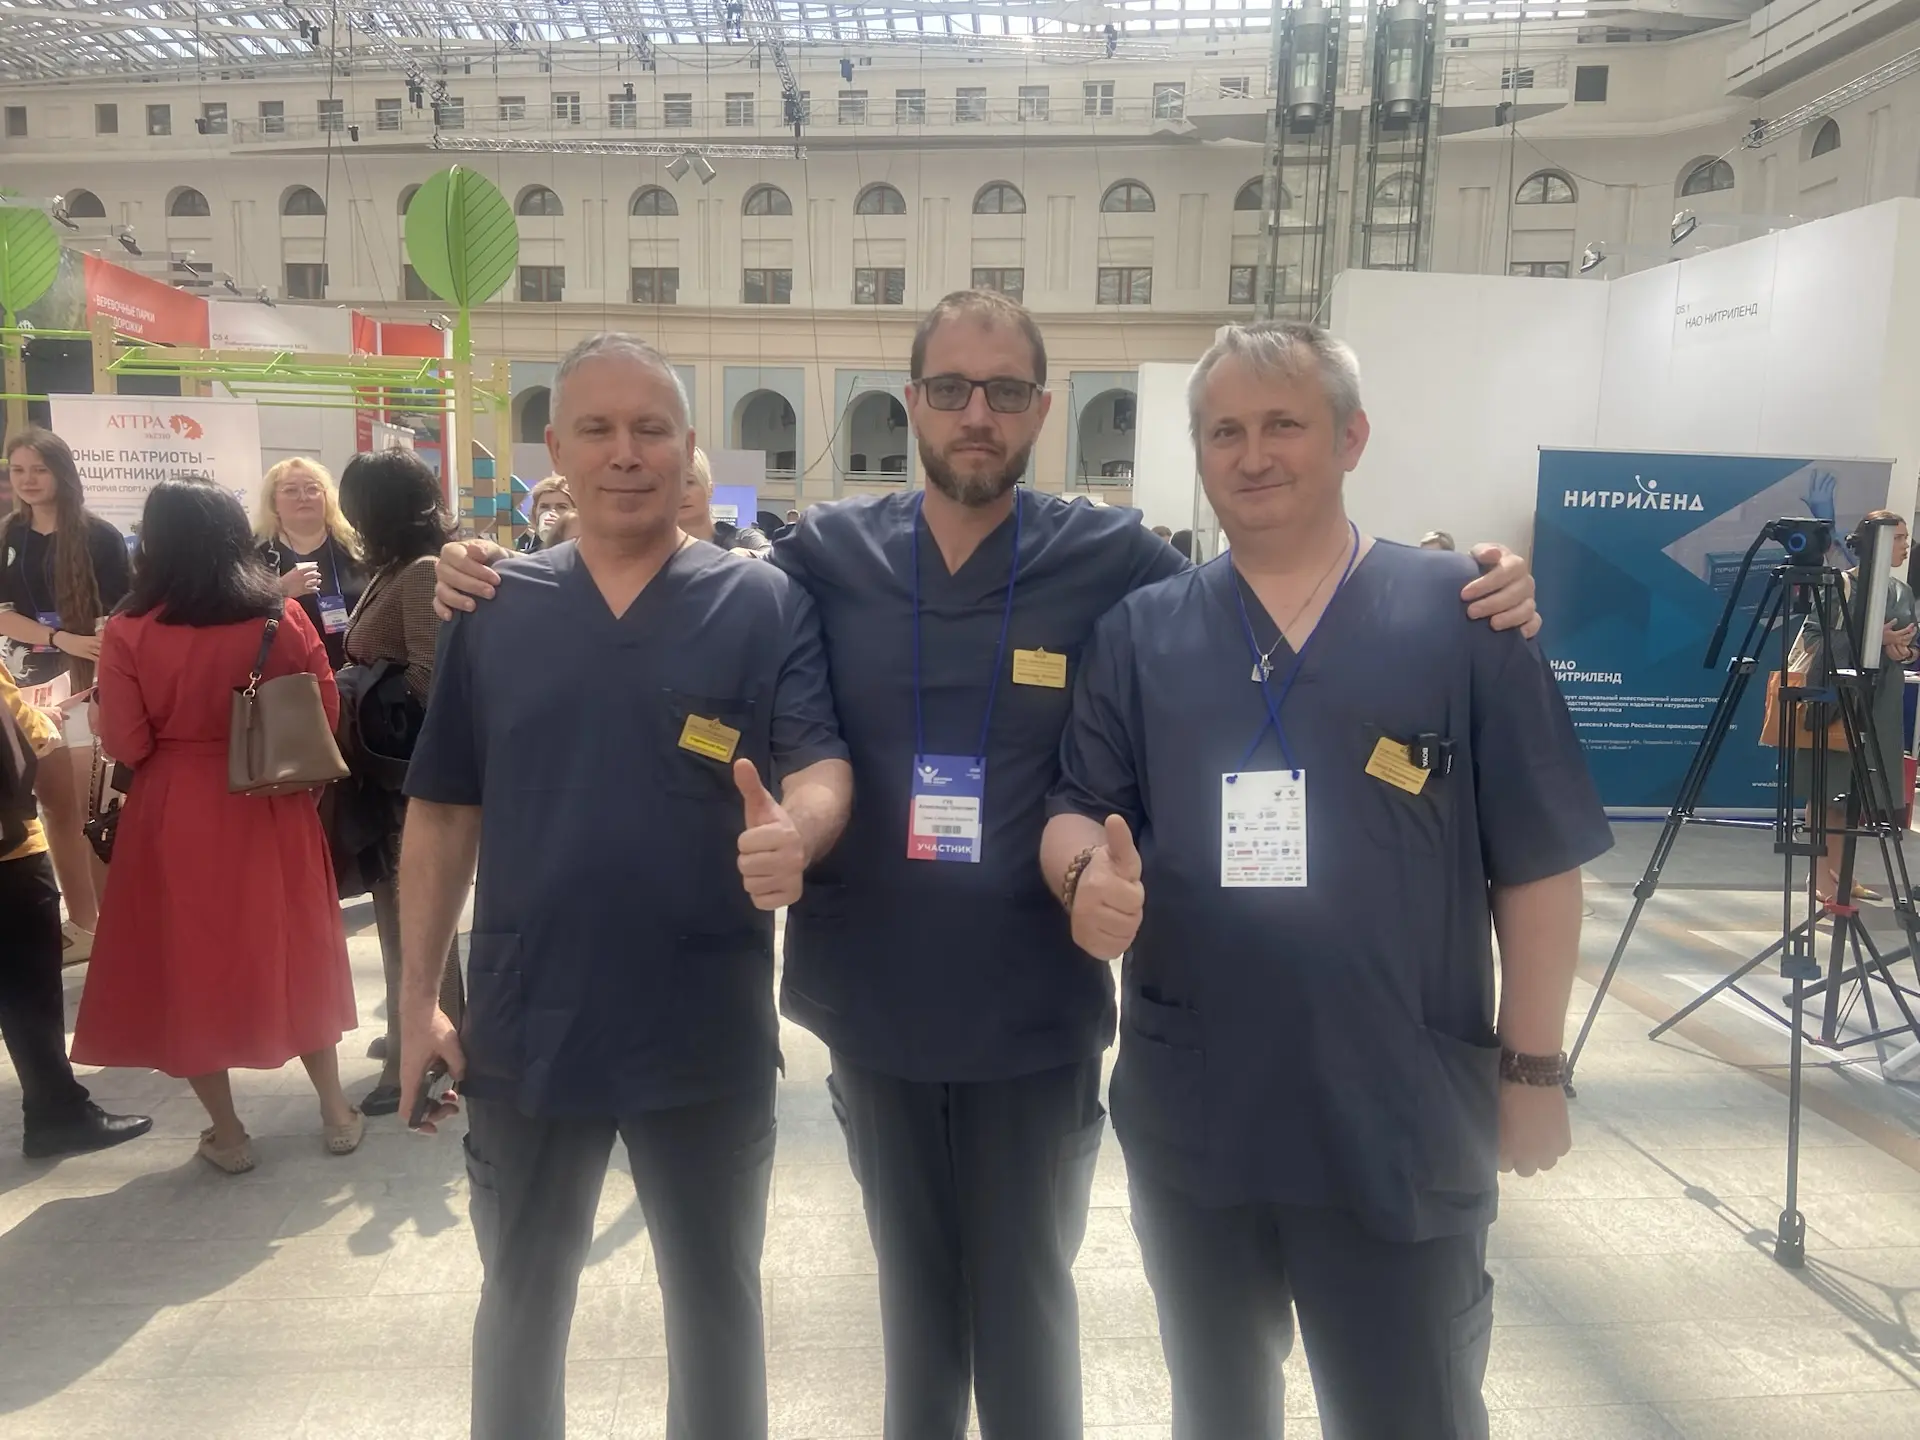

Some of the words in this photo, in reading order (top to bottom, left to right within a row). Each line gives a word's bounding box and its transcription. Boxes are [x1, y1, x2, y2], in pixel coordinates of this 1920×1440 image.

[1685, 315, 1703, 329] НАО
[1704, 302, 1759, 325] НИТРИЛЕНД
[106, 414, 166, 430] АТТРА
[120, 450, 202, 464] ПАТРИОТЫ
[78, 466, 166, 481] АЩИТНИКИ
[1563, 489, 1705, 511] НИТРИЛЕНД
[1550, 660, 1577, 670] НАО
[916, 843, 973, 855] УЧАСТНИК
